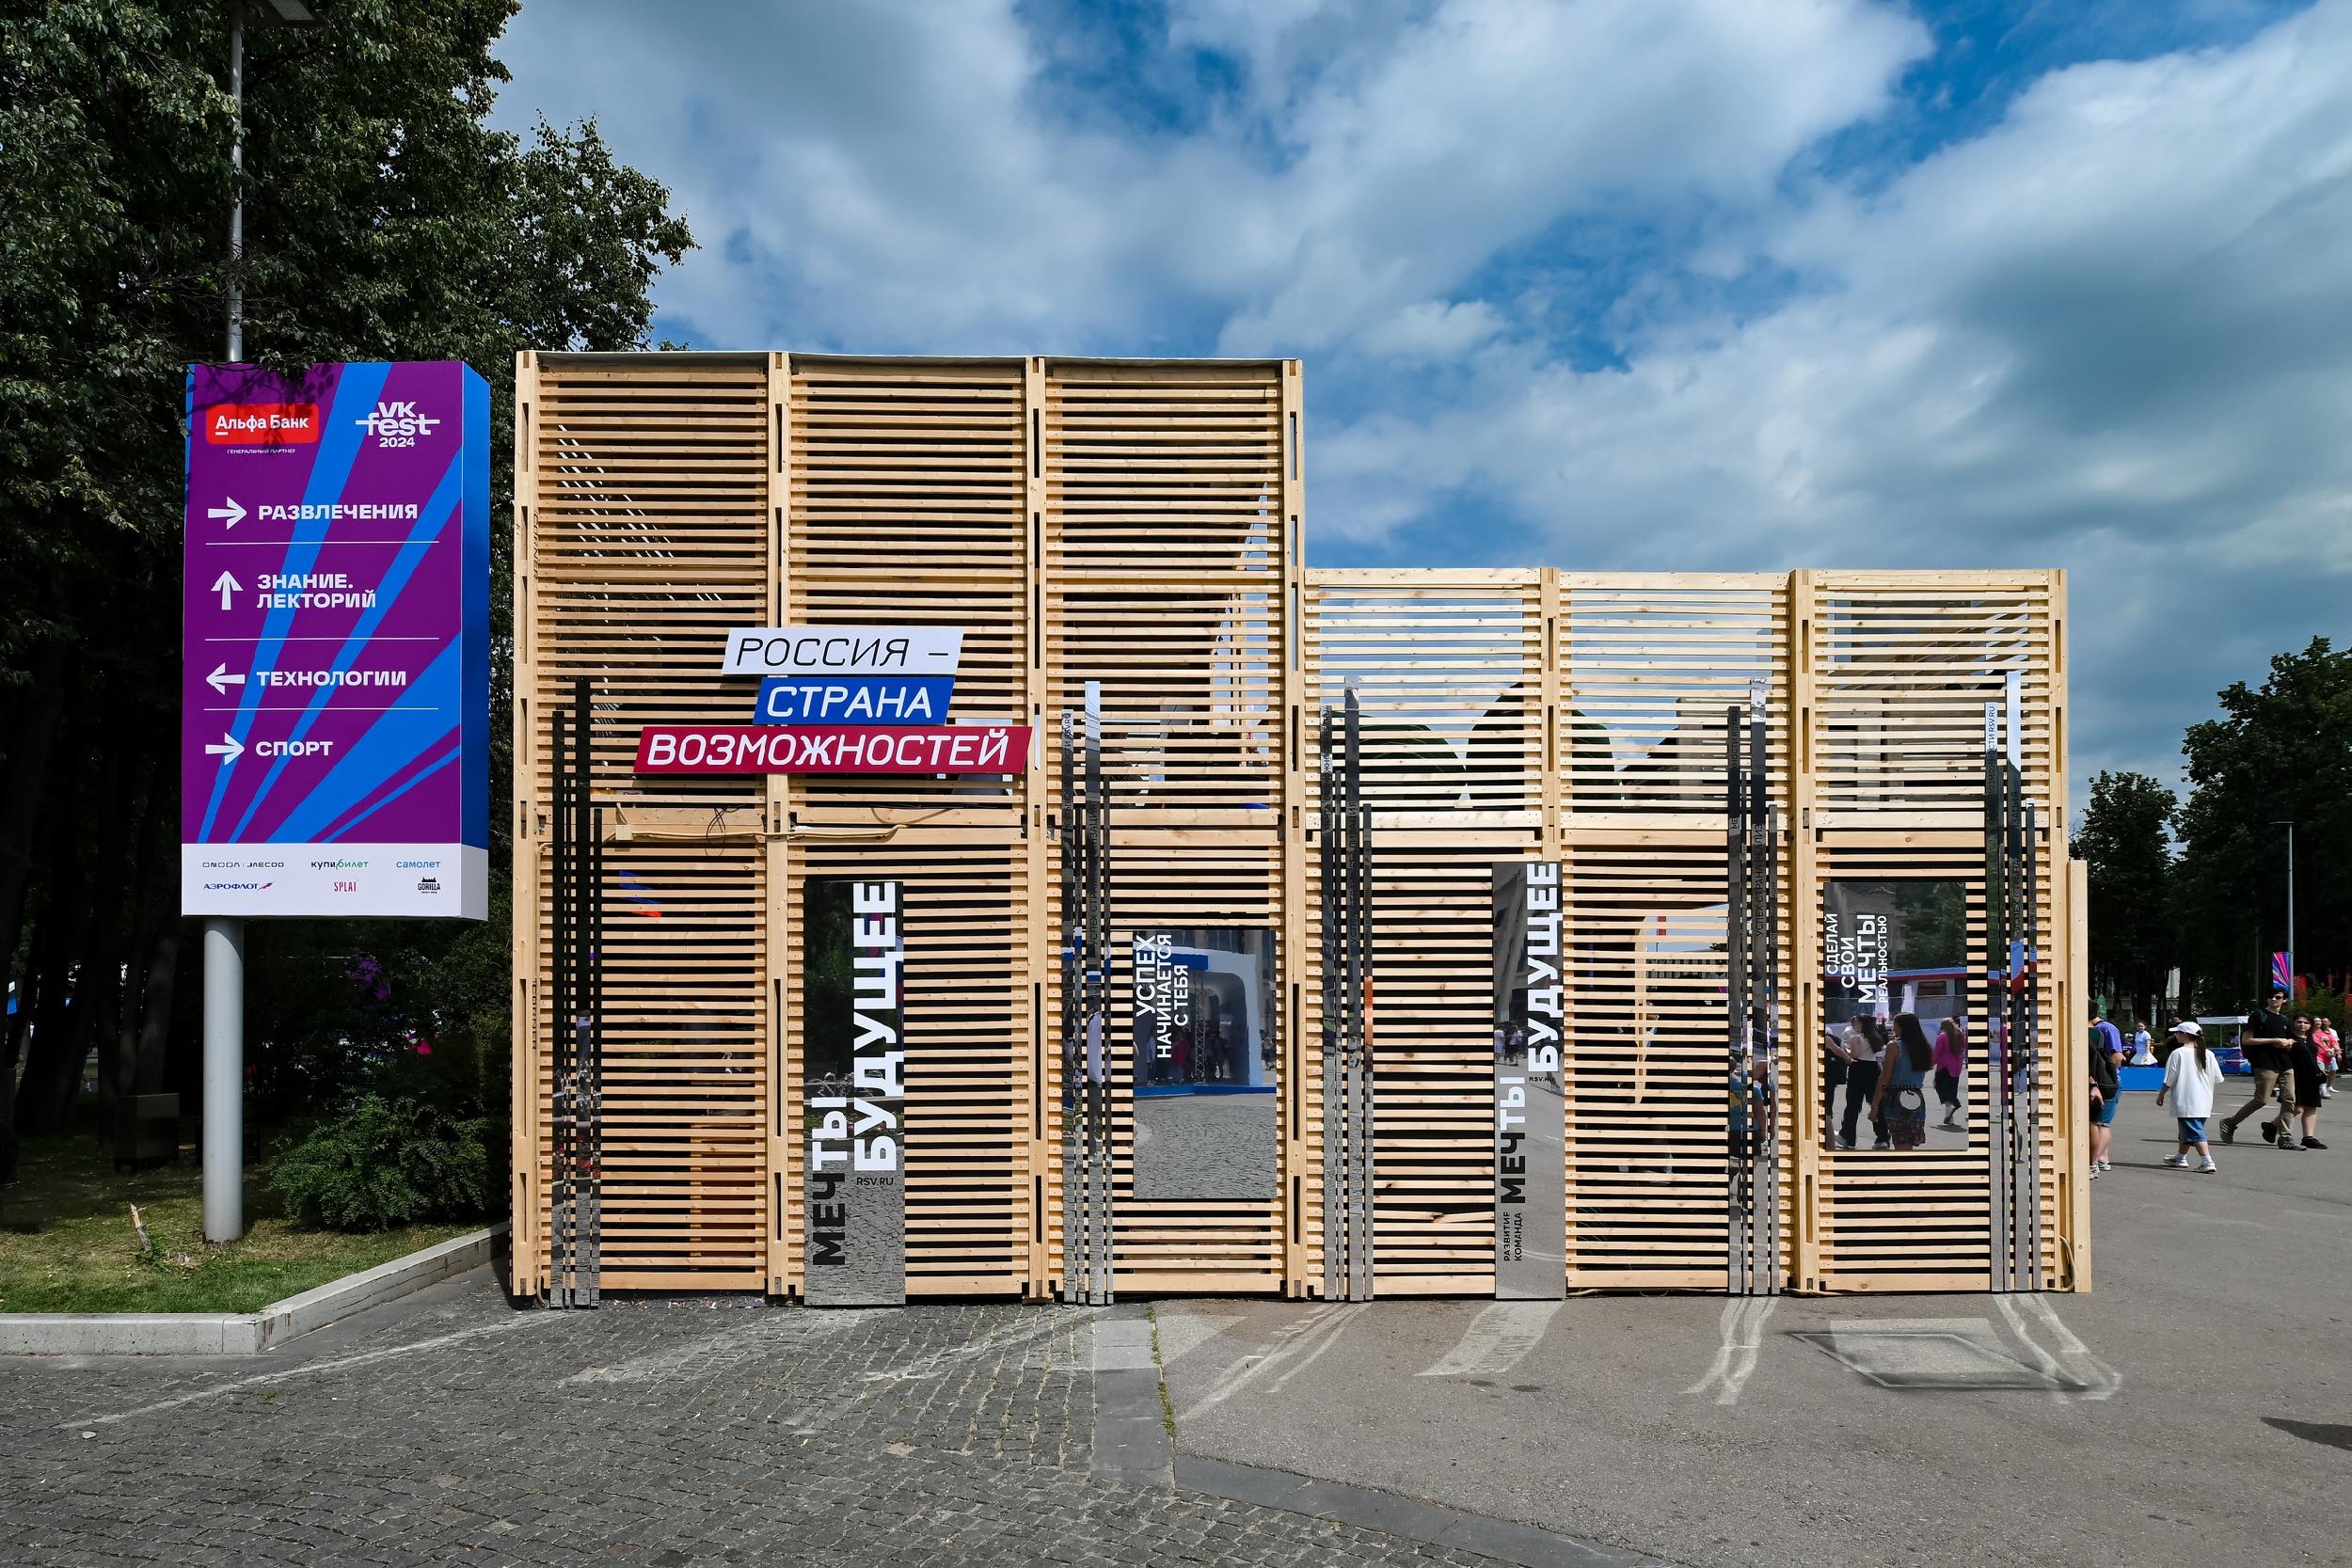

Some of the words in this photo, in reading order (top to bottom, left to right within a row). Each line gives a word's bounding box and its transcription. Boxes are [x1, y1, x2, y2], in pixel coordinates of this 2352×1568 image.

[215, 415, 266, 434] Альфа
[270, 415, 309, 428] Банк
[357, 412, 439, 436] fest
[378, 402, 417, 418] VK
[379, 437, 415, 447] 2024
[258, 503, 418, 521] РАЗВЛЕЧЕНИЯ
[257, 574, 354, 590] ЗНАНИЕ.
[257, 590, 376, 609] ЛЕКТОРИЙ
[737, 638, 910, 666] РОССИЯ
[256, 671, 406, 687] ТЕХНОЛОГИИ
[767, 687, 932, 718] СТРАНА
[256, 740, 334, 756] СПОРТ
[647, 728, 1009, 766] ВОЗМОЖНОСТЕЙ
[310, 859, 369, 870] купибилет
[333, 881, 357, 892] SPLAT
[1755, 864, 1764, 903] СТРАНА
[1089, 914, 1098, 945] УСПЕХ
[1755, 905, 1764, 937] УСПЕХ
[1823, 912, 1839, 975] СДЕЛАЙ
[1856, 914, 1877, 1004] МЕЧТЫ
[1526, 863, 1565, 1072] БУДУЩЕЕ
[1840, 937, 1856, 989] СВОИ
[1877, 915, 1889, 1004] РЕАЛЬНОСТЬЮ
[1136, 935, 1156, 1018] УСПЕХ
[1173, 964, 1189, 1010] ТЕБЯ
[1156, 934, 1172, 1058] НАЧИНАЕТСЯ
[853, 881, 904, 1171] БУДУЩЕЕ
[1173, 1013, 1189, 1027] С
[1499, 1076, 1526, 1204] МЕЧТЫ
[811, 1097, 848, 1266] МЕЧТЫ
[856, 1177, 894, 1186] RSV.RU
[1514, 1212, 1522, 1261] КОМАНДА
